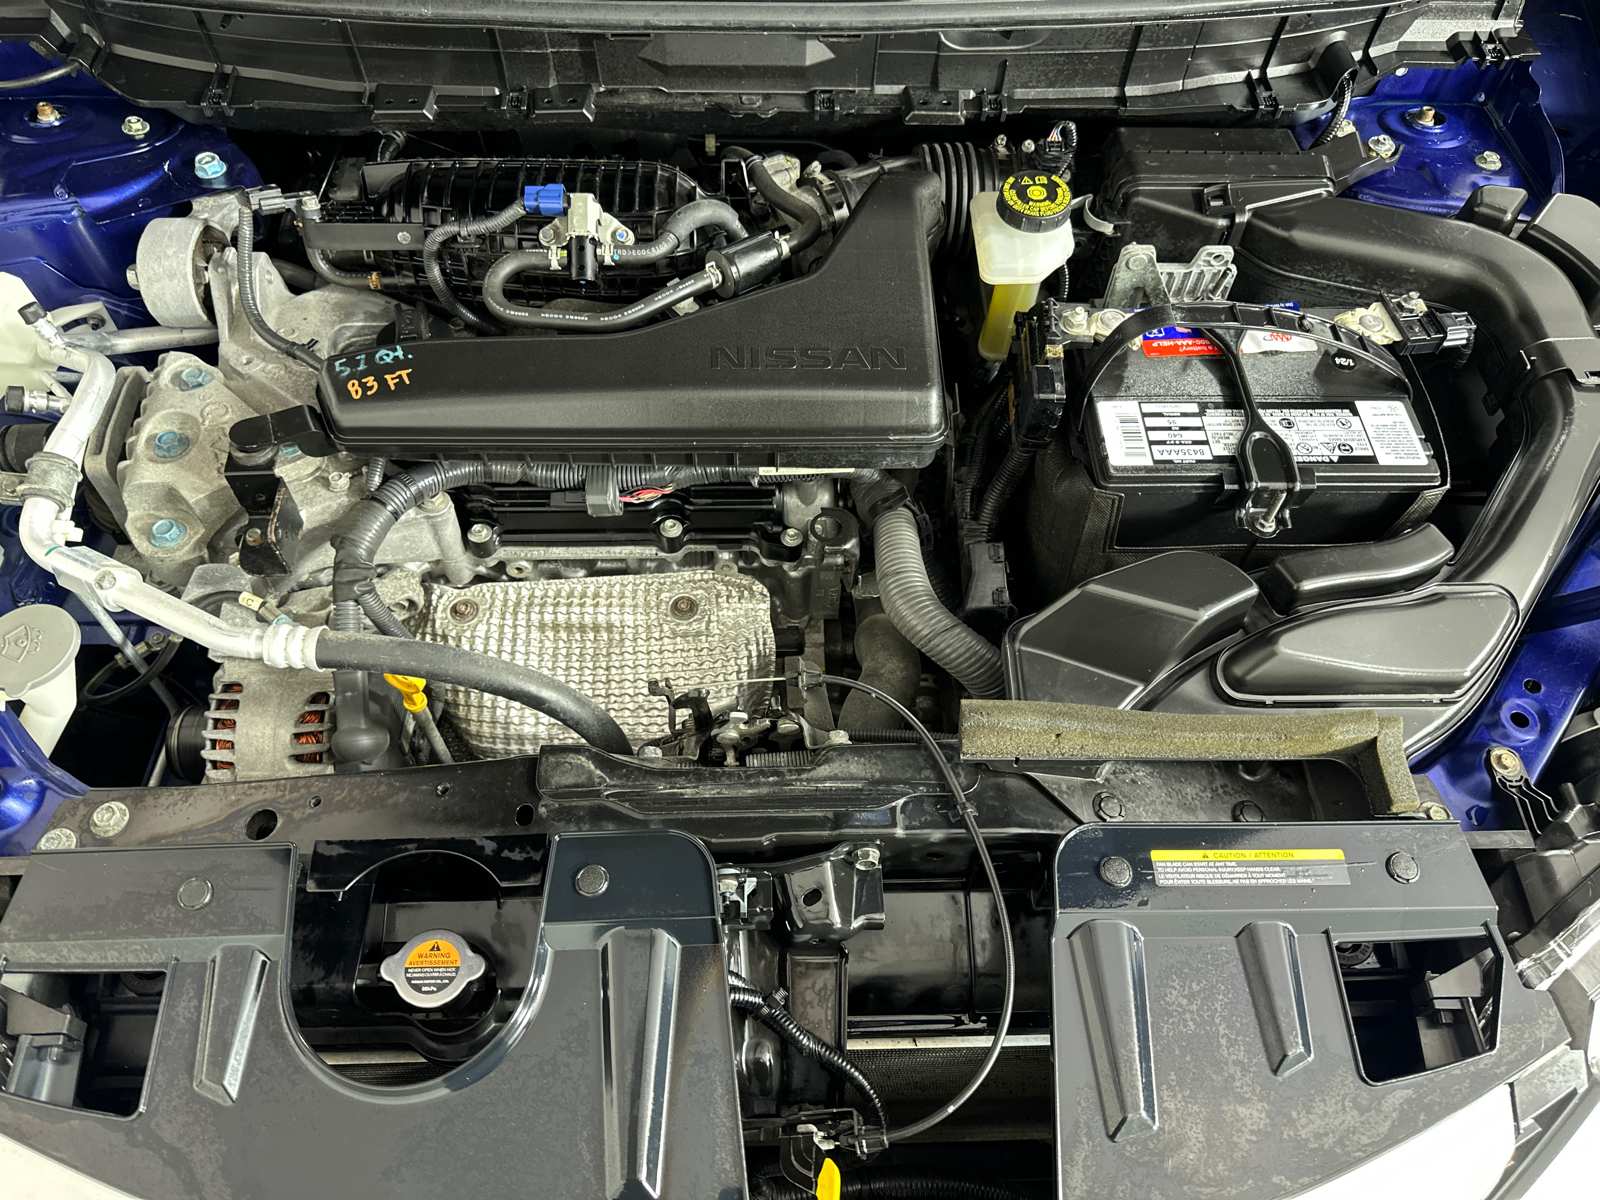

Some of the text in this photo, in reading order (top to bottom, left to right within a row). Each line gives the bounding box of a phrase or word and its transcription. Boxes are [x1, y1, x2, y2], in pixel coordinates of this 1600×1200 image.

[711, 346, 907, 370] NISSAN
[347, 368, 413, 400] 83 FT
[1156, 448, 1206, 456] 8435AAA
[1254, 851, 1294, 859] ATTENTION
